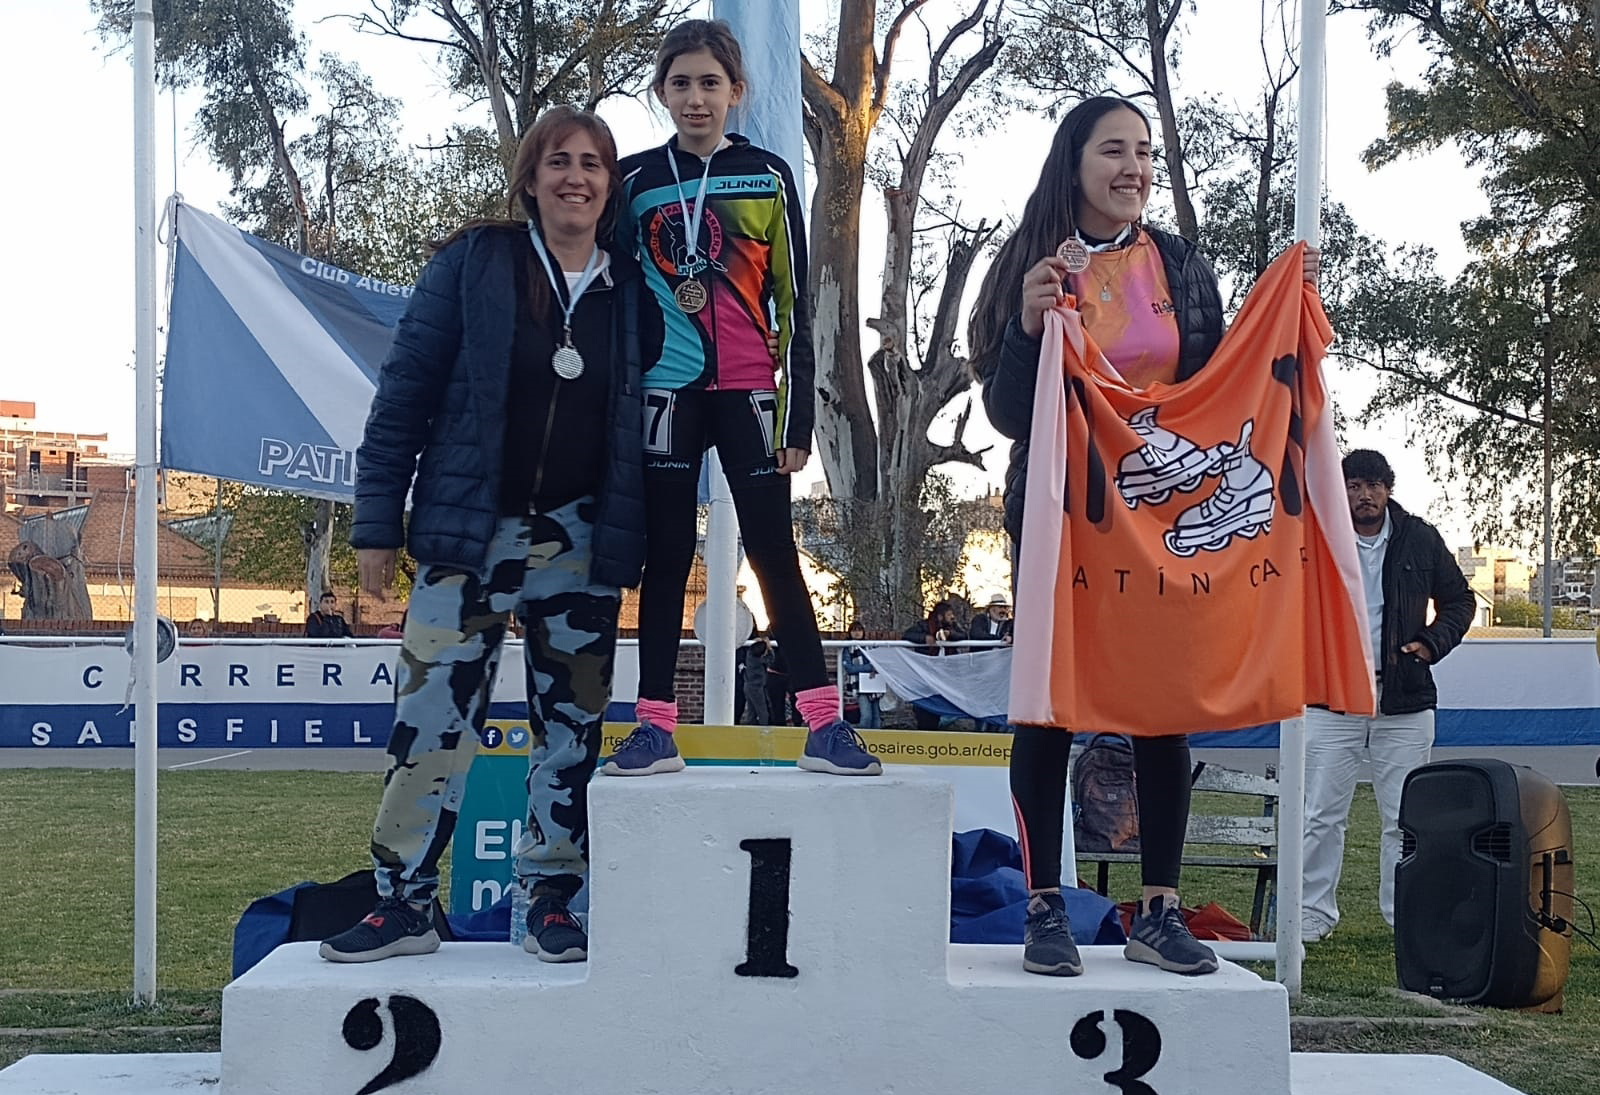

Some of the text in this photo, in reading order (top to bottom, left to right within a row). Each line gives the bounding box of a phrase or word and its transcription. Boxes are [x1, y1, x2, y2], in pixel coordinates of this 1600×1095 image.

[715, 178, 772, 189] JUNIN
[300, 257, 350, 285] Club
[646, 394, 669, 446] 7
[258, 437, 355, 486] PATI
[647, 461, 690, 469] JUNIN
[82, 662, 393, 688] CRRERA
[31, 717, 372, 746] SASFIEL
[734, 837, 800, 978] 1
